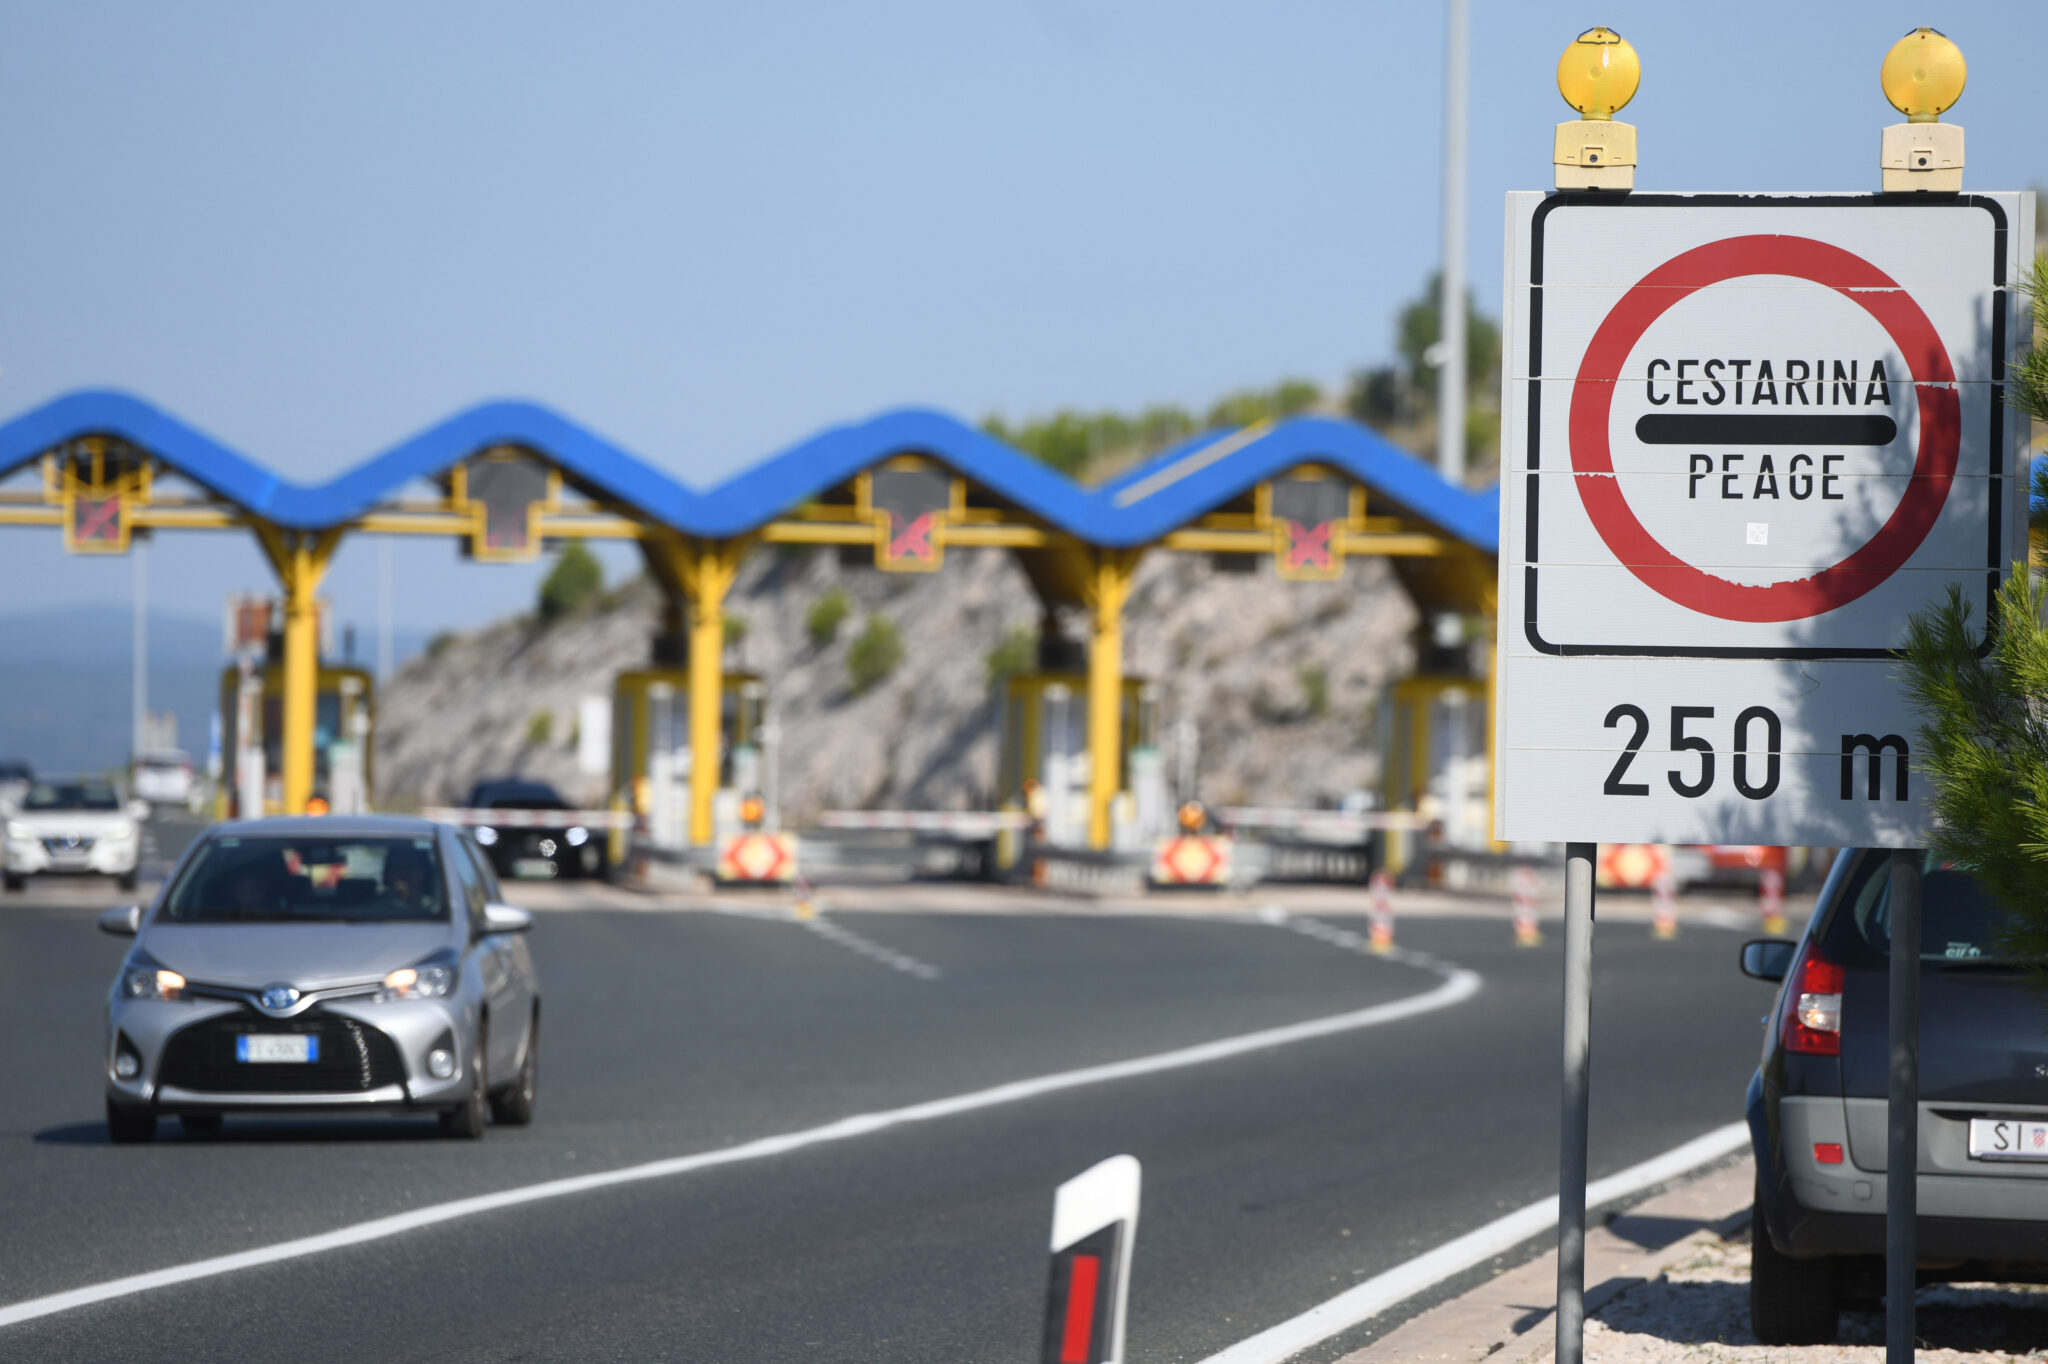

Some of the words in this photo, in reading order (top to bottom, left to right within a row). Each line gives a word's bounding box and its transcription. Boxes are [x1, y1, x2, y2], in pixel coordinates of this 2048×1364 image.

[1647, 359, 1892, 405] CESTARINA
[1689, 454, 1844, 500] PEAGE
[1603, 703, 1781, 800] 250
[1840, 733, 1909, 801] m
